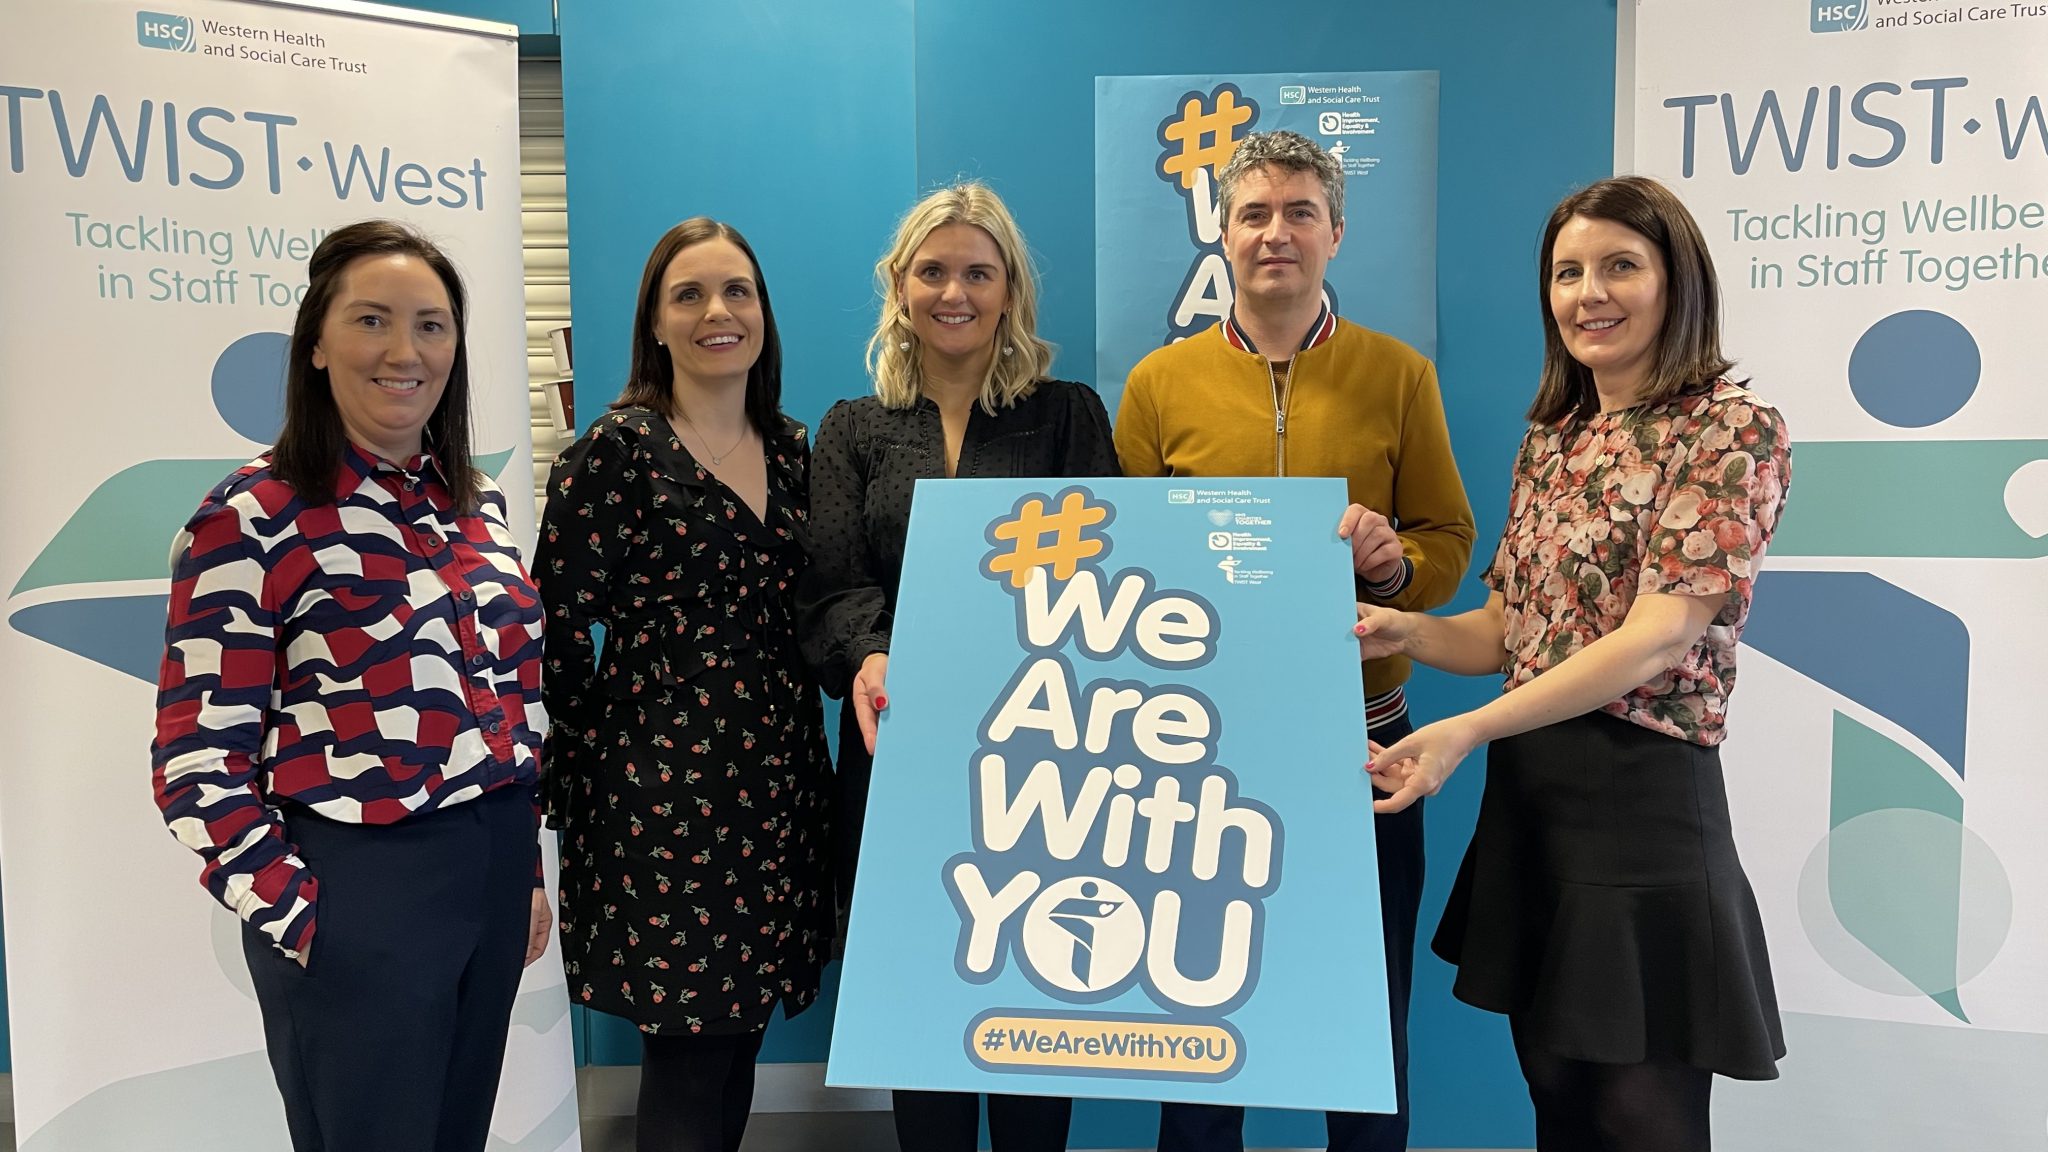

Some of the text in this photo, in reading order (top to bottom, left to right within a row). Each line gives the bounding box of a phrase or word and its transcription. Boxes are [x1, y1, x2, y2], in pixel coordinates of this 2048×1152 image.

[144, 22, 184, 41] HSC
[1818, 5, 1856, 22] HSC
[1875, 3, 2048, 29] and Social Care Trus
[202, 20, 325, 48] Western Health
[204, 43, 367, 74] and Social Care Trust
[1283, 91, 1300, 99] HSC
[1307, 86, 1337, 94] Western
[1323, 96, 1344, 104] Social
[0, 86, 487, 210] TWIST West
[1663, 77, 1969, 179] TWIST
[65, 212, 233, 265] Tackling
[1727, 194, 2045, 245] Tackling Wellbe
[98, 264, 133, 299] in
[149, 268, 238, 304] Staff
[1750, 242, 2048, 291] in Staff Togeth
[1024, 566, 1211, 662] We
[988, 658, 1211, 764] Are
[980, 753, 1273, 888] With
[953, 862, 1253, 1007] YOU
[982, 1028, 1227, 1062] #WeAreWithYOU
